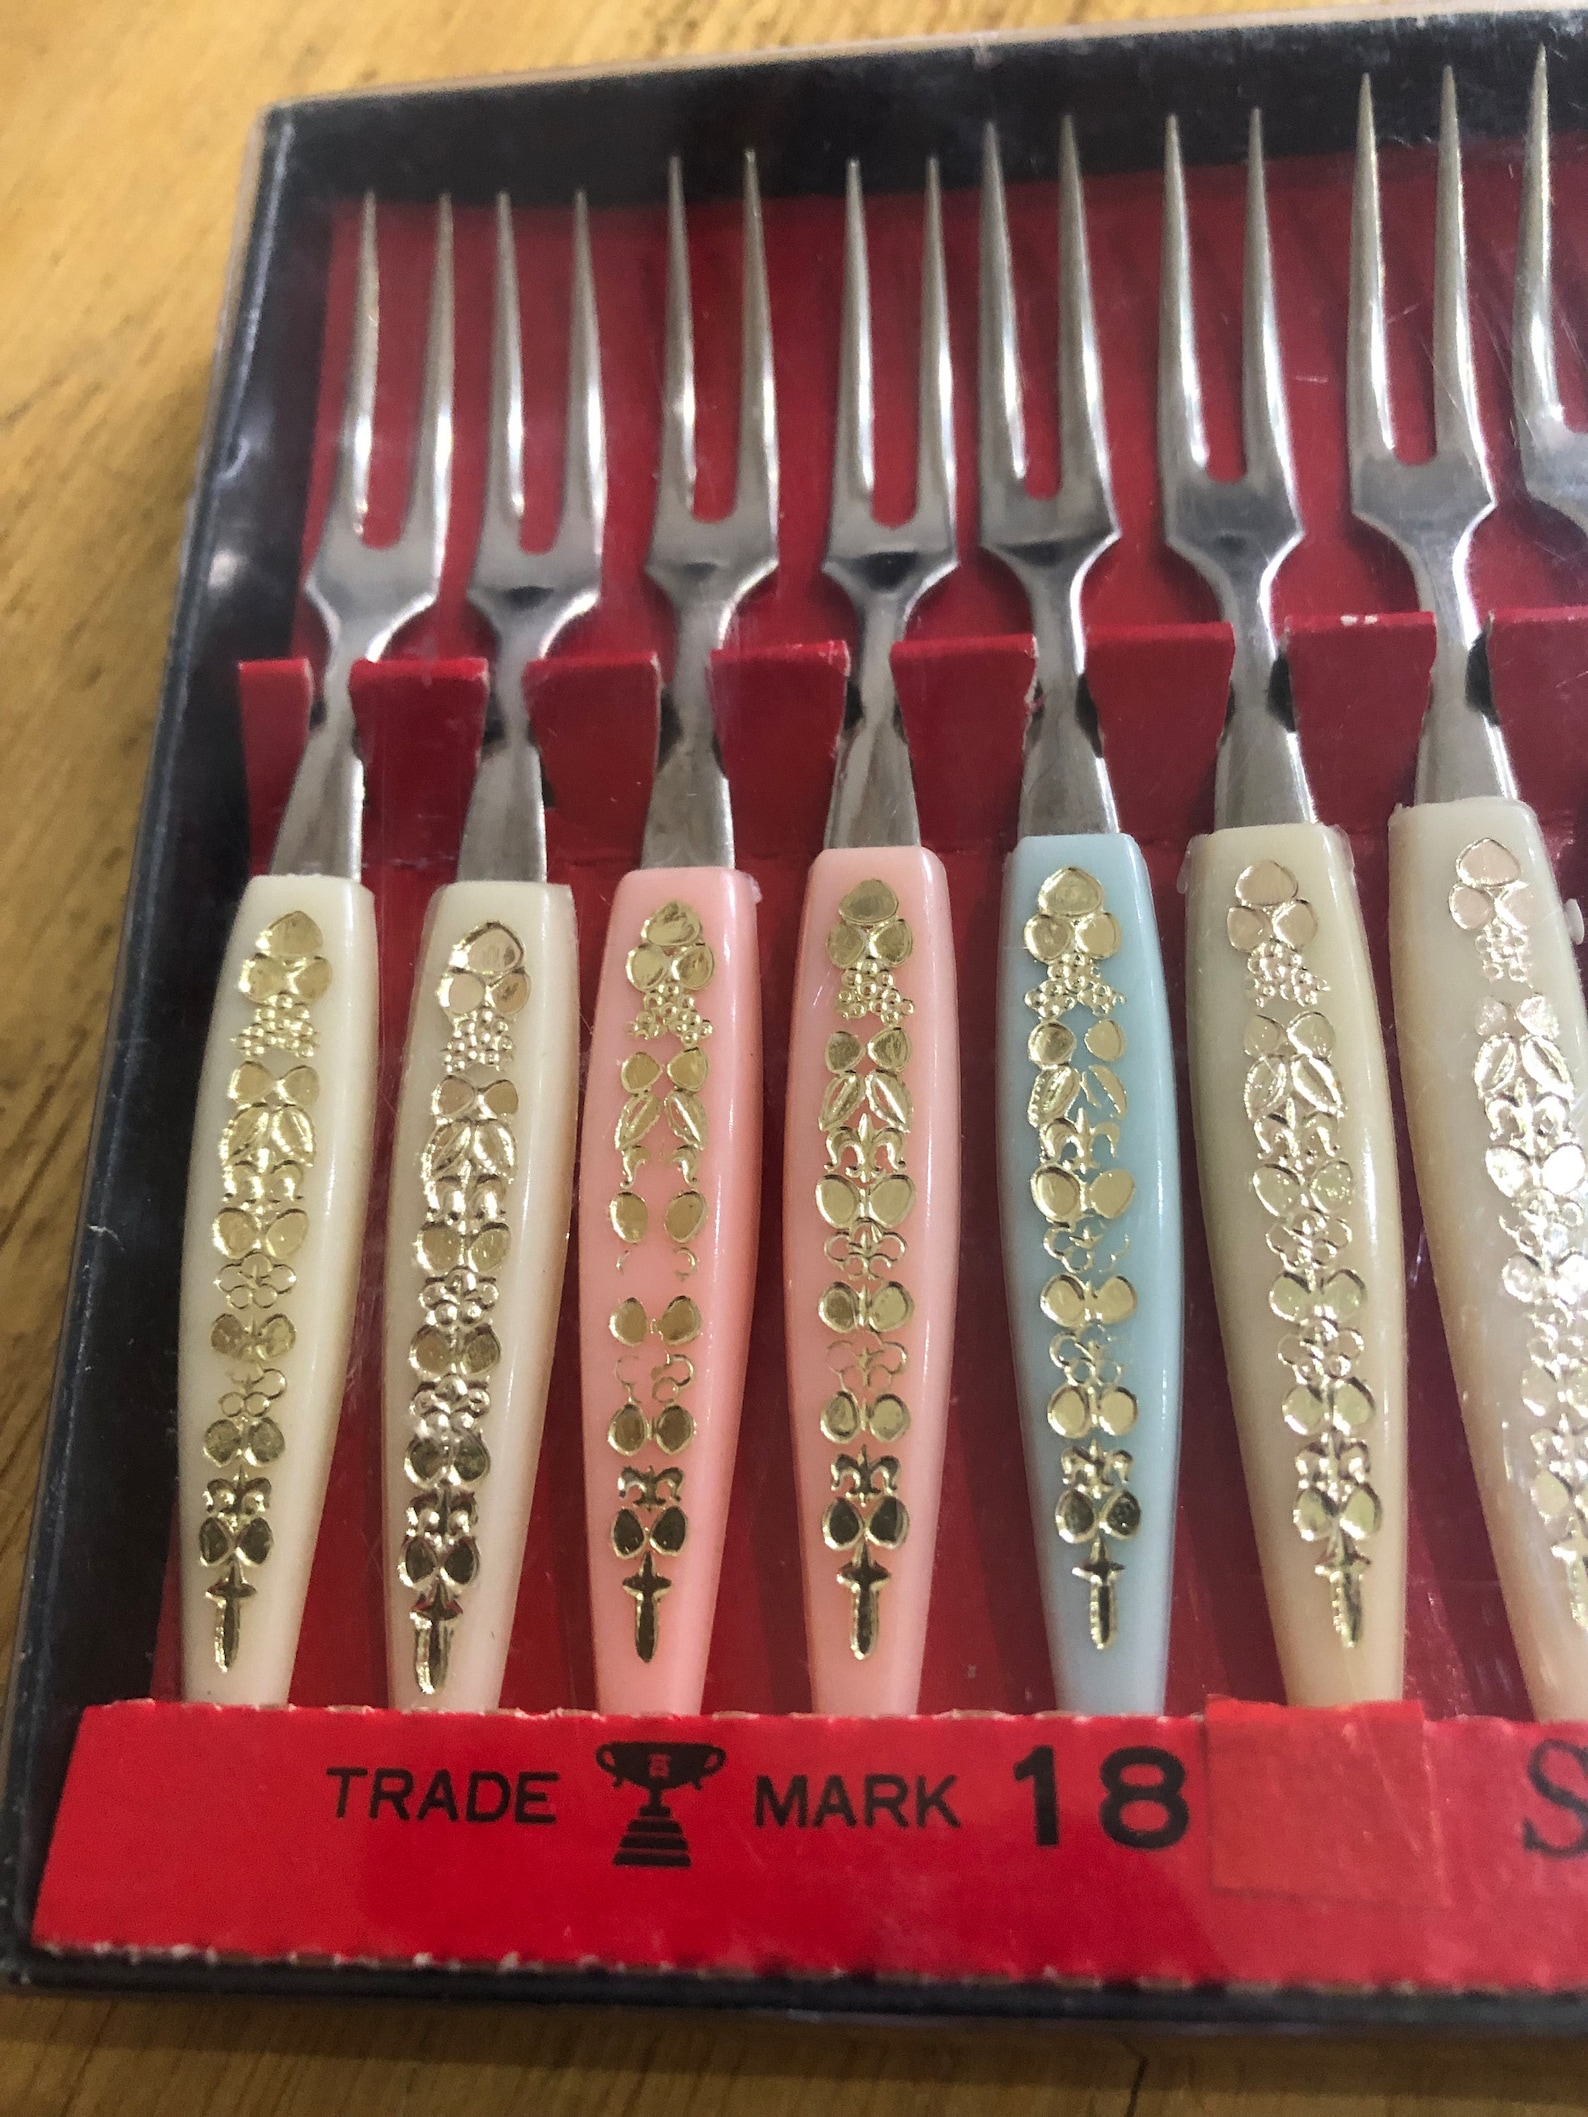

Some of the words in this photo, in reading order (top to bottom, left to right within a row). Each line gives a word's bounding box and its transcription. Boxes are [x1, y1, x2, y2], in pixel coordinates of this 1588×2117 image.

[326, 1766, 560, 1826] TRADE
[754, 1773, 960, 1829] MARK
[1013, 1745, 1191, 1851] 18
